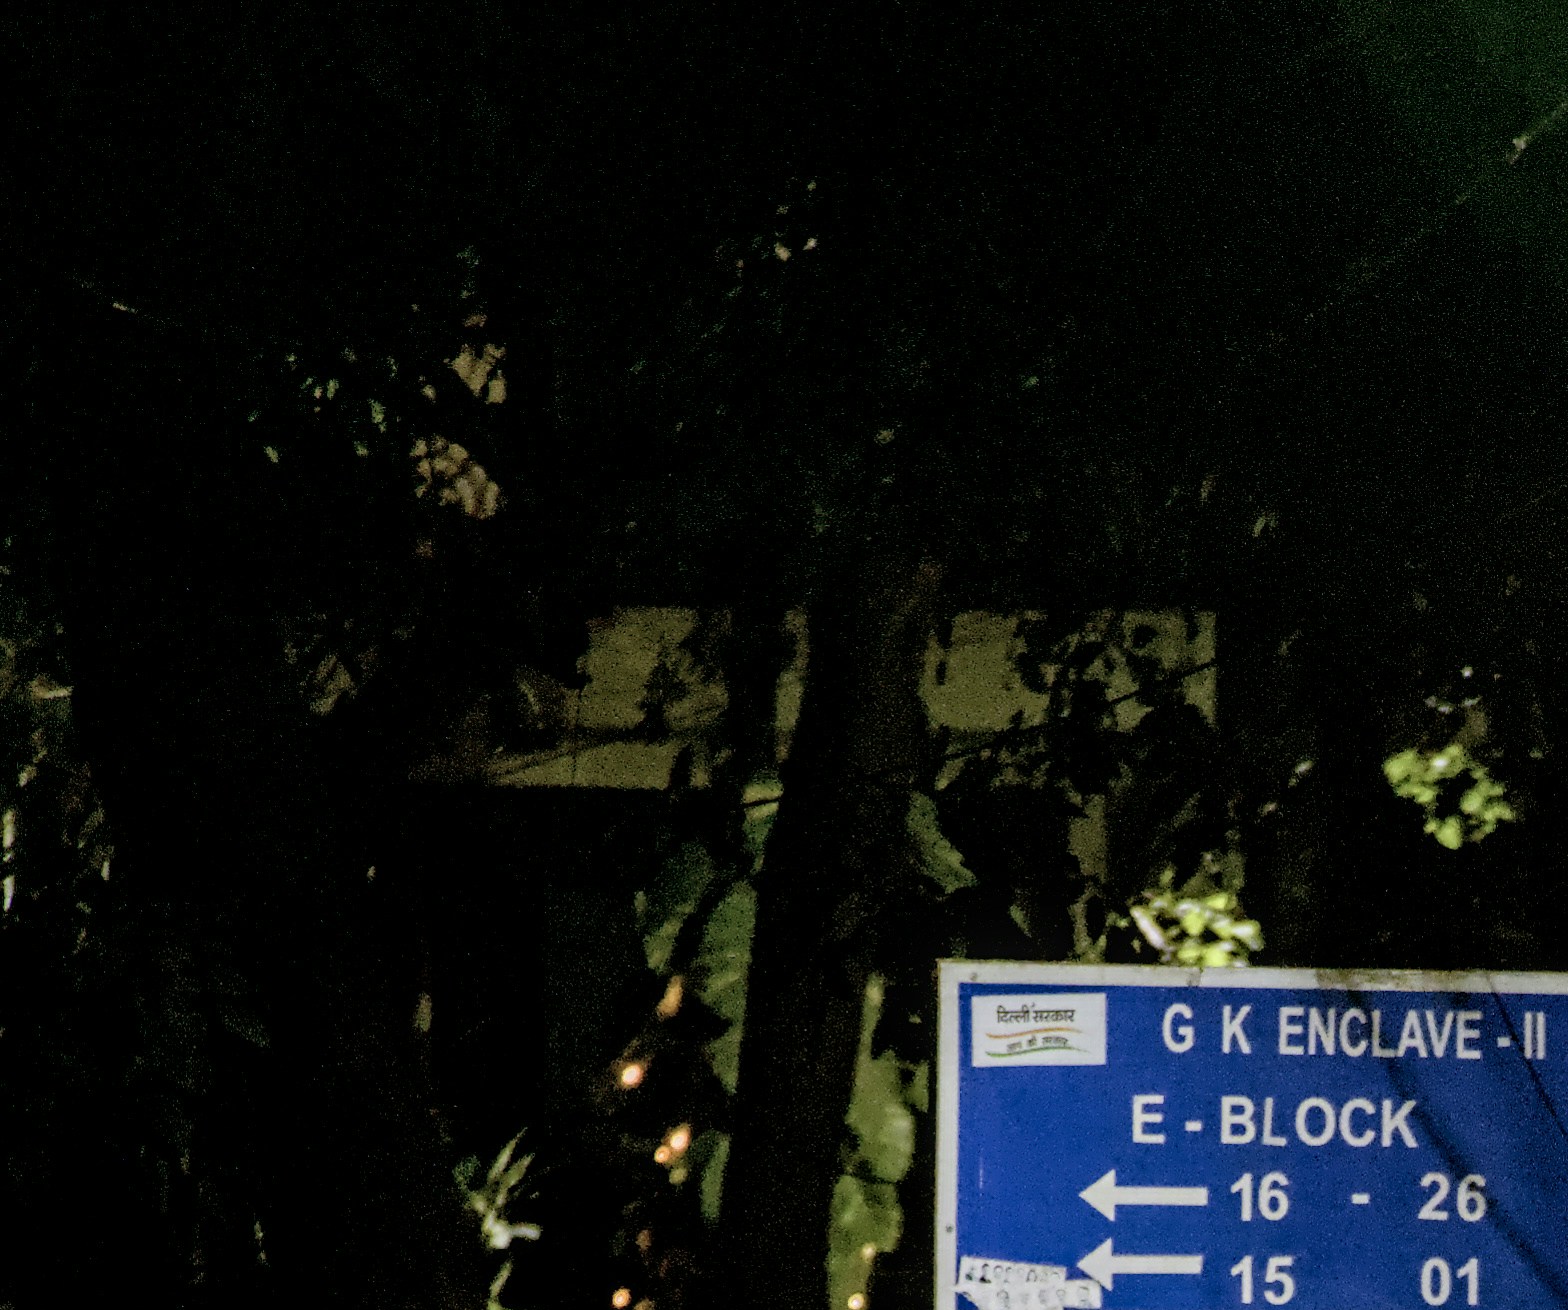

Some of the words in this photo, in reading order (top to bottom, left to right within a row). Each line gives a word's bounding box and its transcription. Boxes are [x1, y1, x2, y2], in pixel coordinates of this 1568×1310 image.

[1161, 1002, 1196, 1054] G
[1221, 1004, 1252, 1055] K
[1277, 1005, 1483, 1060] ENCLAVE
[1220, 1094, 1419, 1149] BLOCK
[1230, 1170, 1291, 1222] 16
[1417, 1171, 1488, 1223] 26
[1230, 1254, 1296, 1306] 15
[1420, 1256, 1480, 1307] 01
